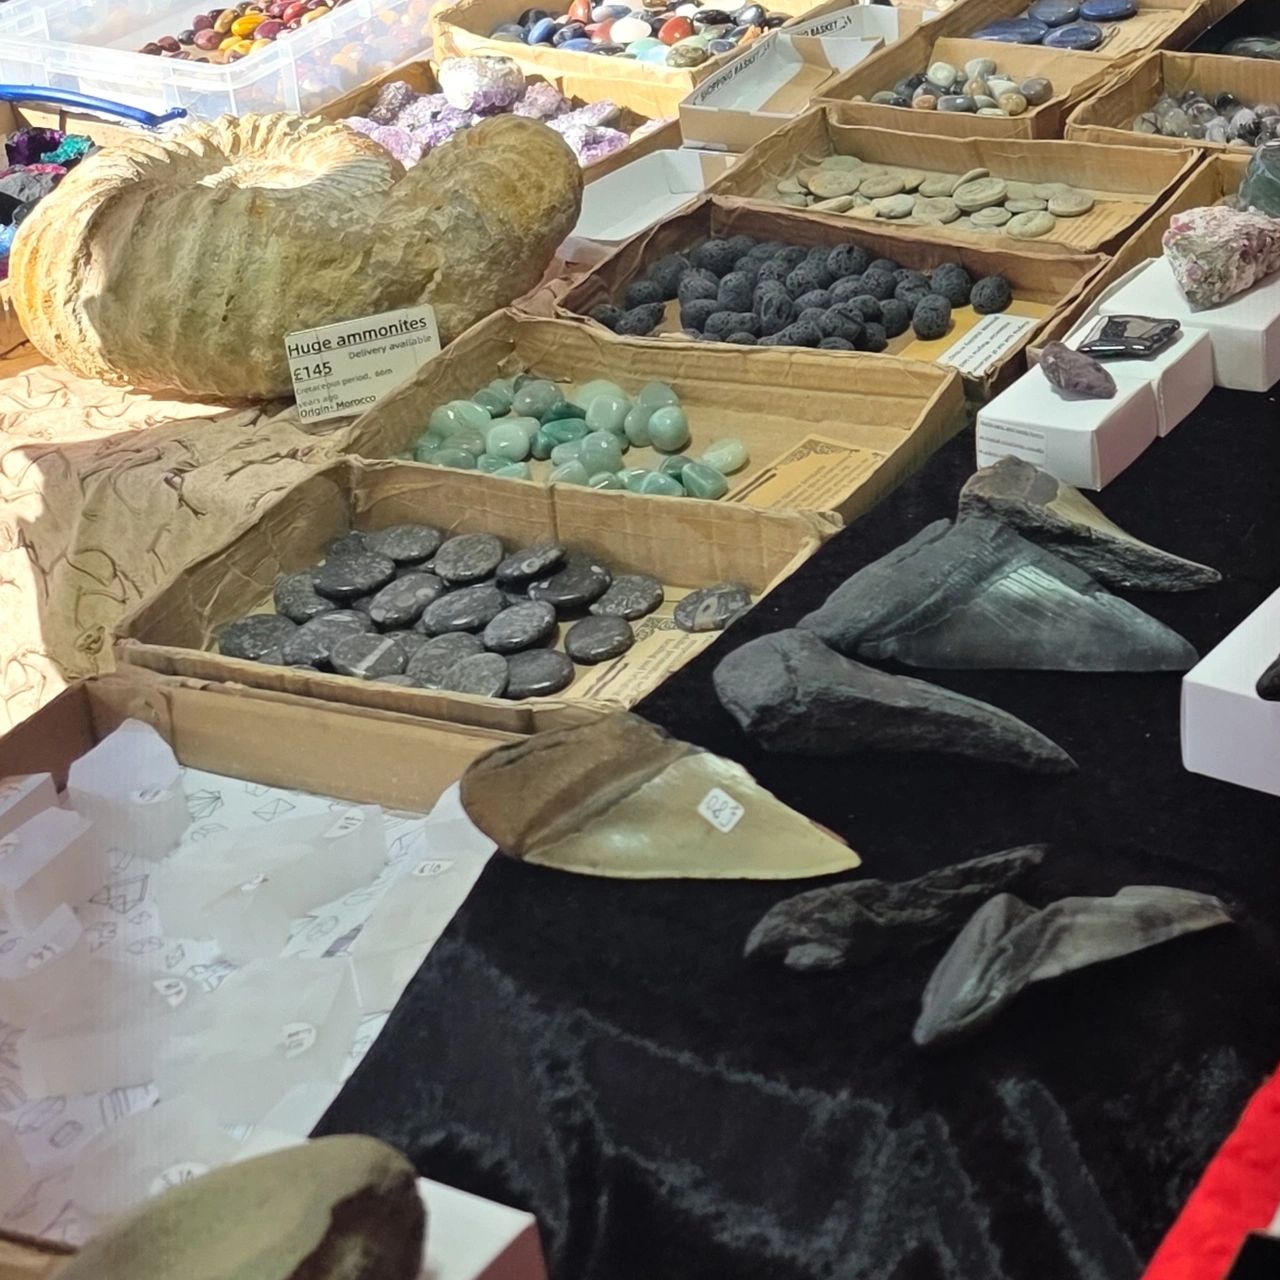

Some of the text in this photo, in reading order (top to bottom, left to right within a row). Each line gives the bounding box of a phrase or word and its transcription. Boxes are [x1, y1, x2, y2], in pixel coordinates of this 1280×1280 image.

[810, 20, 838, 37] BASKET
[700, 50, 761, 102] SHOPPING BASKET
[288, 317, 428, 357] Huge ammonites
[348, 334, 433, 360] Delivery available
[293, 361, 333, 381] £145
[296, 380, 341, 395] Cretaceous
[335, 394, 377, 411] Morocco
